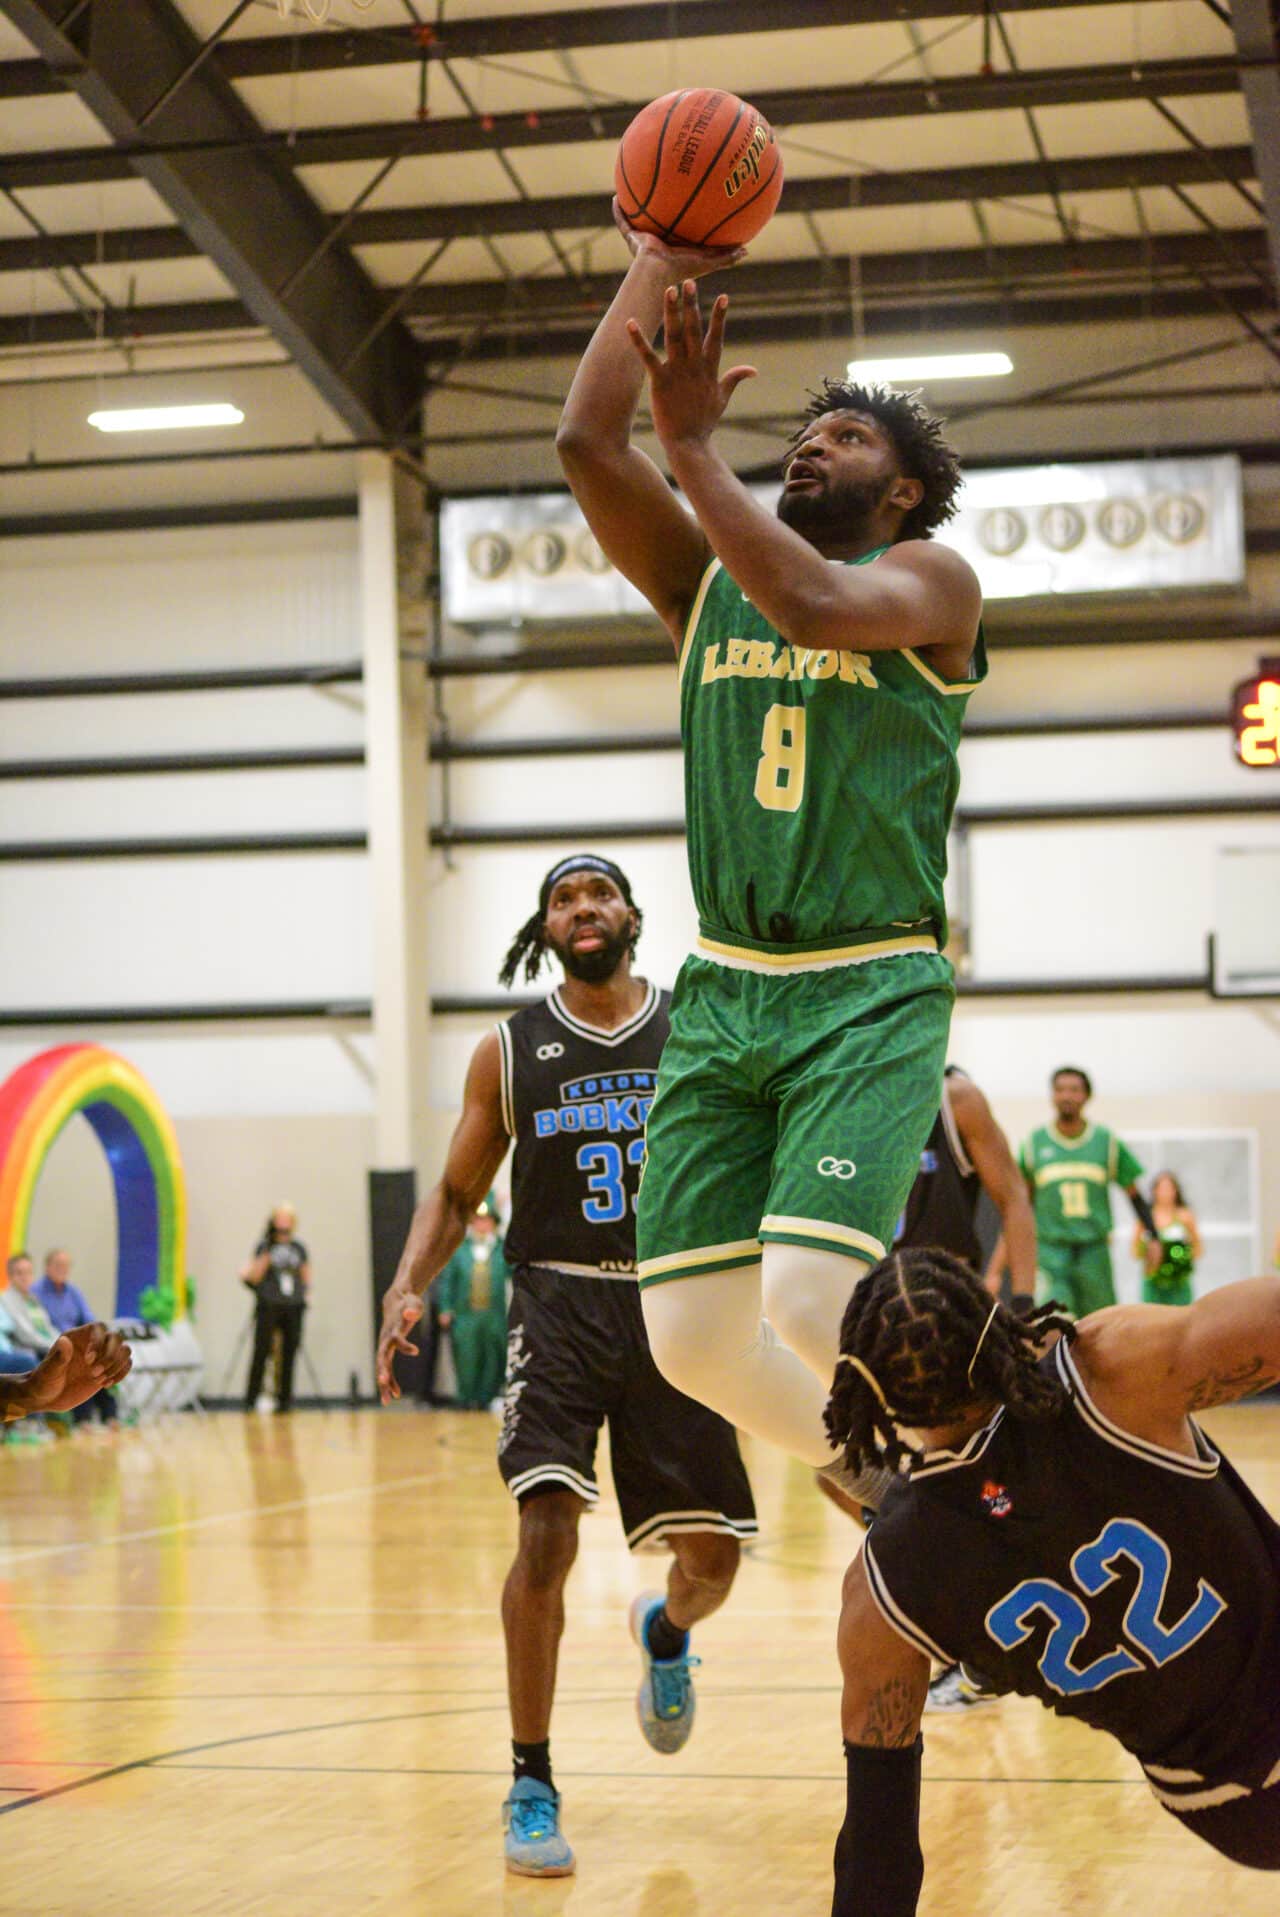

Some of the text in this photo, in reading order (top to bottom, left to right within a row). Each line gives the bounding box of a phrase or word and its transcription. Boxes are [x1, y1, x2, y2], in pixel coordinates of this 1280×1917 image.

[677, 135, 703, 177] LEAGUE
[723, 122, 770, 199] aden
[753, 703, 807, 813] 8
[567, 1073, 658, 1099] KOKOM
[984, 1516, 1229, 1697] 22
